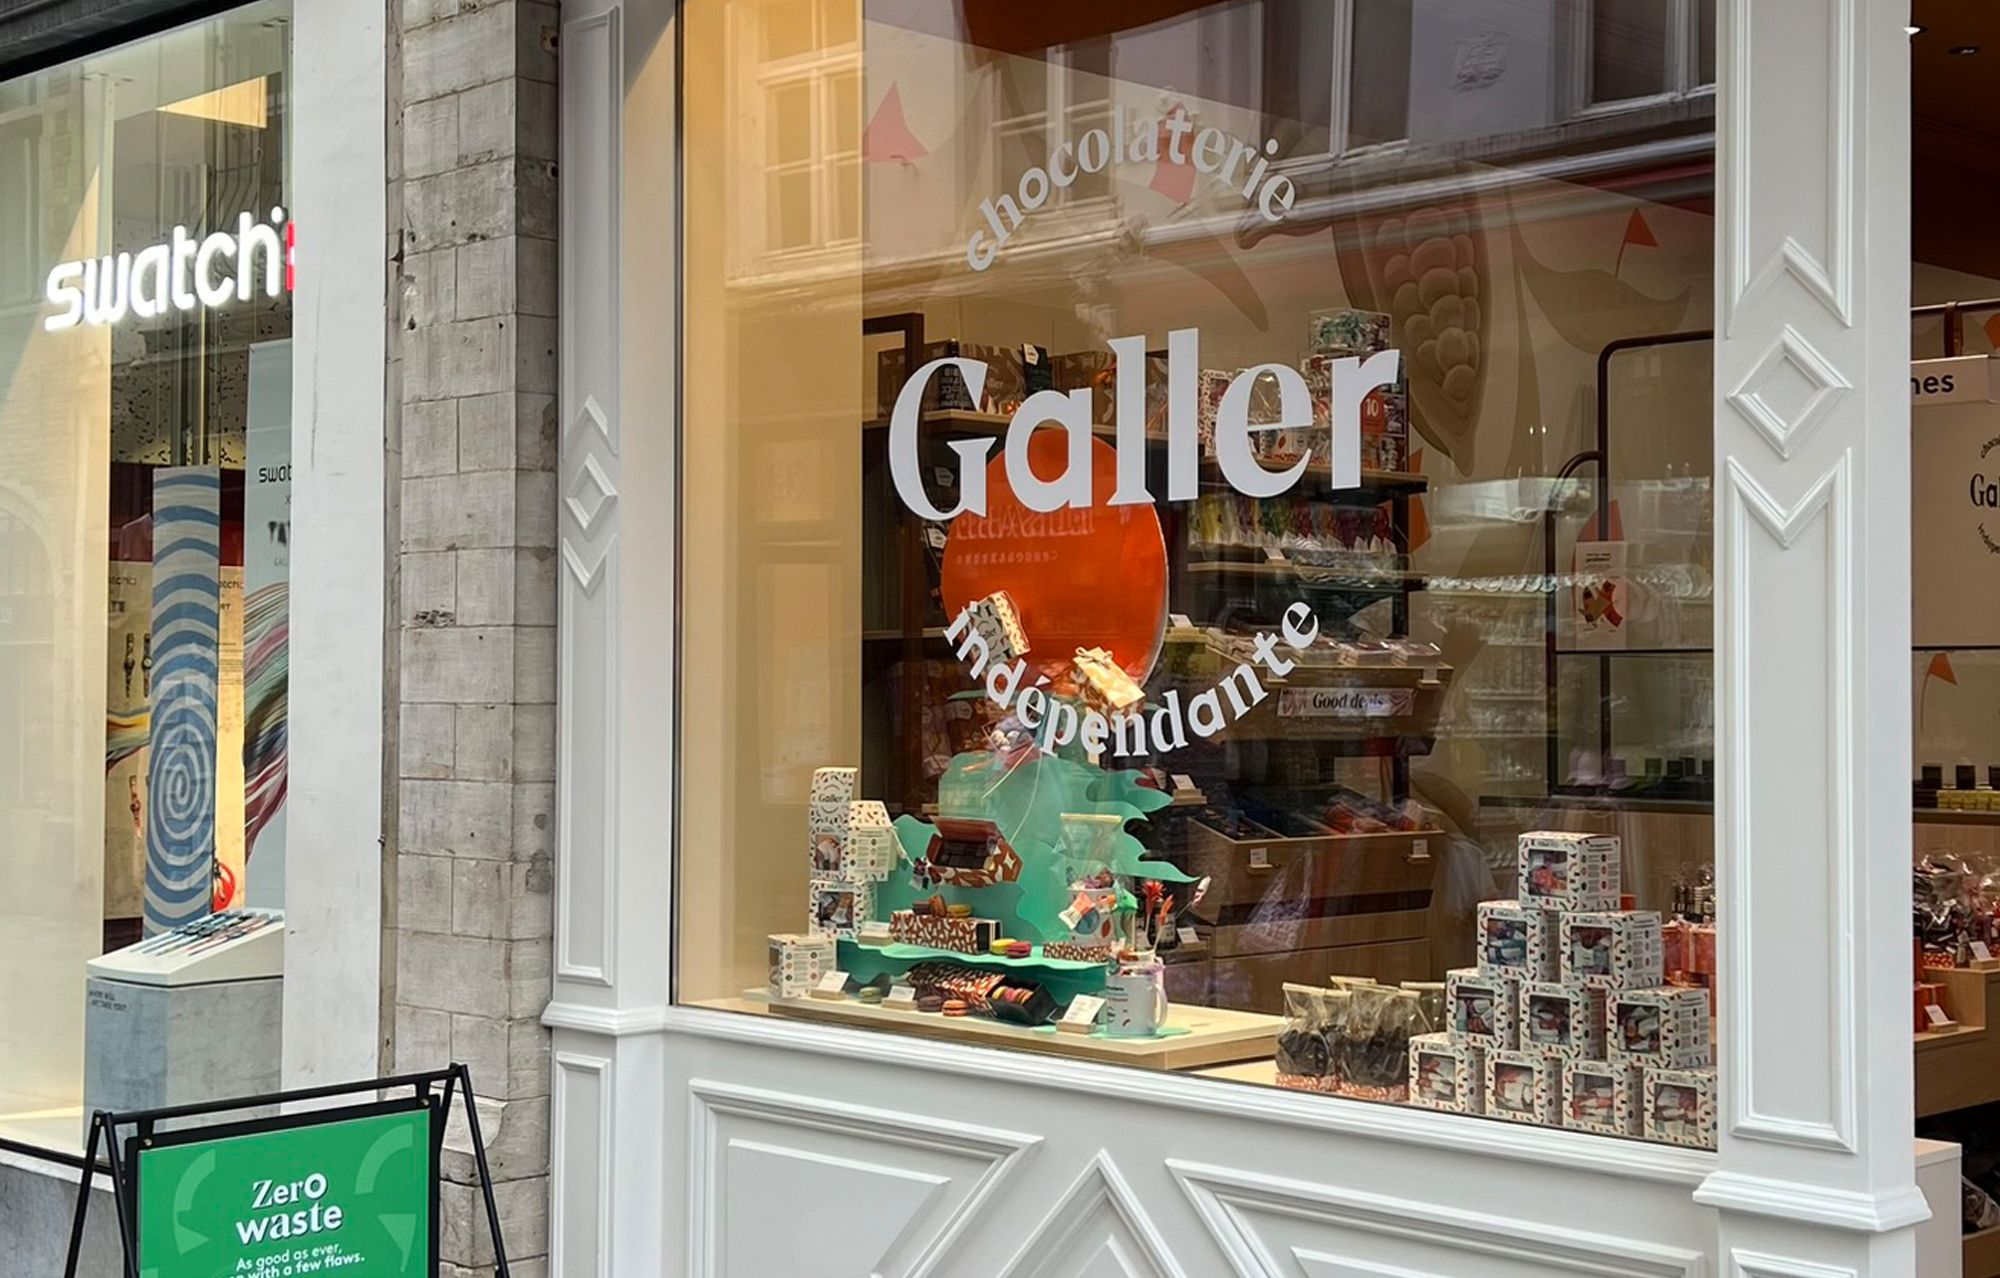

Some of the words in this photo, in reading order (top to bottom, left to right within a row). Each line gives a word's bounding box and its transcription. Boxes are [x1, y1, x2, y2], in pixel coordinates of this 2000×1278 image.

[966, 104, 1296, 272] chocolaterie
[45, 211, 280, 331] swatch
[889, 327, 1400, 521] Galler
[941, 600, 1319, 759] indépendante
[1312, 692, 1348, 709] Good
[252, 1172, 328, 1209] Zero
[235, 1201, 343, 1245] waste
[236, 1257, 253, 1272] As
[256, 1250, 289, 1271] good
[293, 1248, 309, 1260] as
[311, 1243, 342, 1257] ever,
[244, 1266, 280, 1278] with
[283, 1266, 293, 1275] a
[295, 1260, 322, 1273] few
[324, 1252, 366, 1267] flaws.
